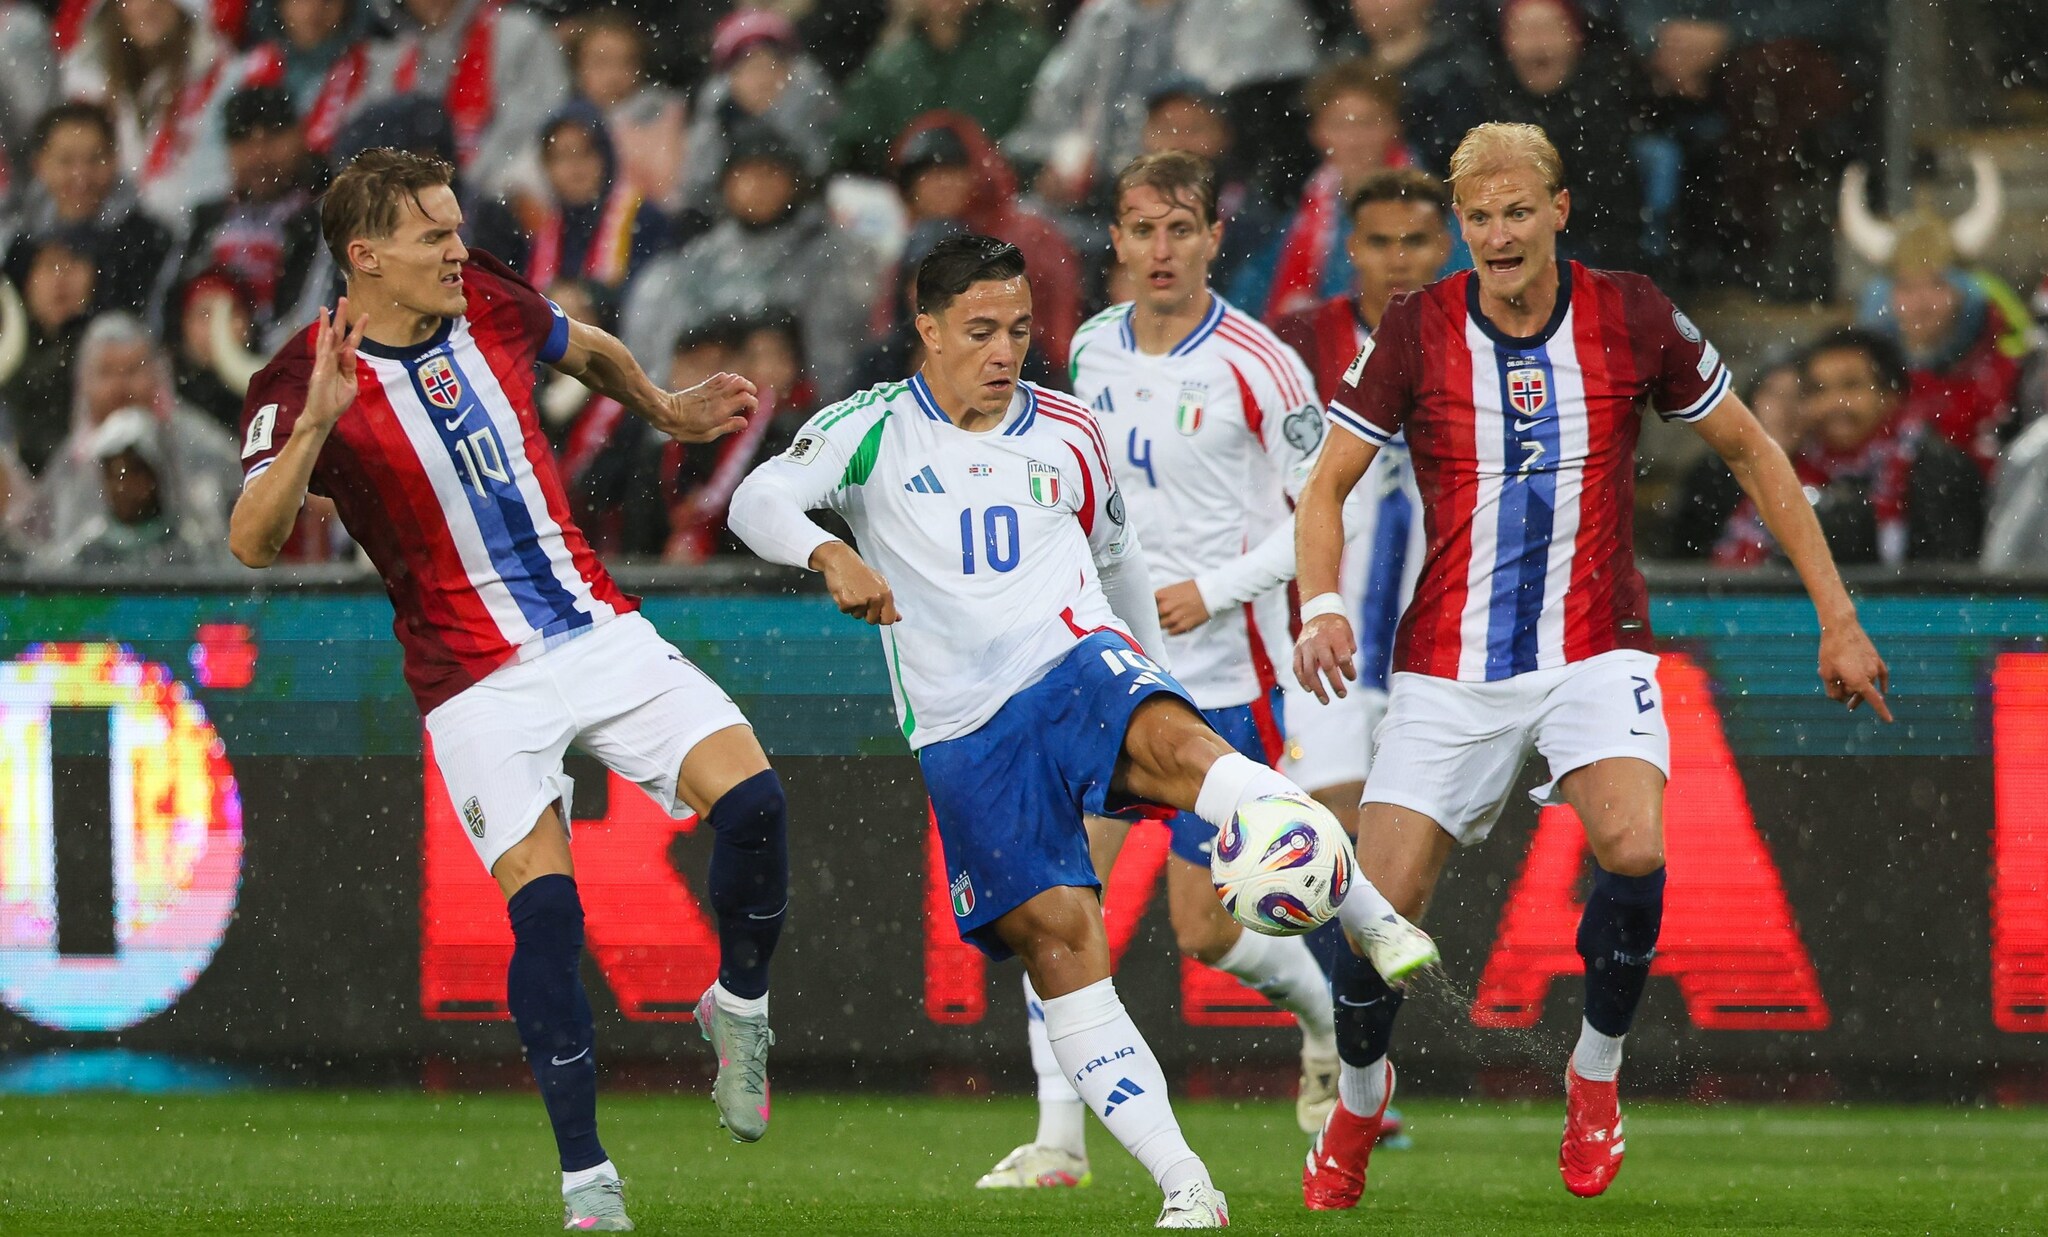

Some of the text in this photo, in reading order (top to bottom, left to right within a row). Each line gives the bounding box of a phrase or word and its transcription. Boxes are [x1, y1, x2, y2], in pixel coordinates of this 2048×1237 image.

[455, 426, 510, 498] 10
[1030, 463, 1057, 474] ITALIA
[1128, 426, 1157, 489] 4
[960, 505, 1021, 575] 10
[1100, 648, 1162, 677] 10
[1630, 675, 1656, 715] 2
[952, 879, 970, 897] ITALIA
